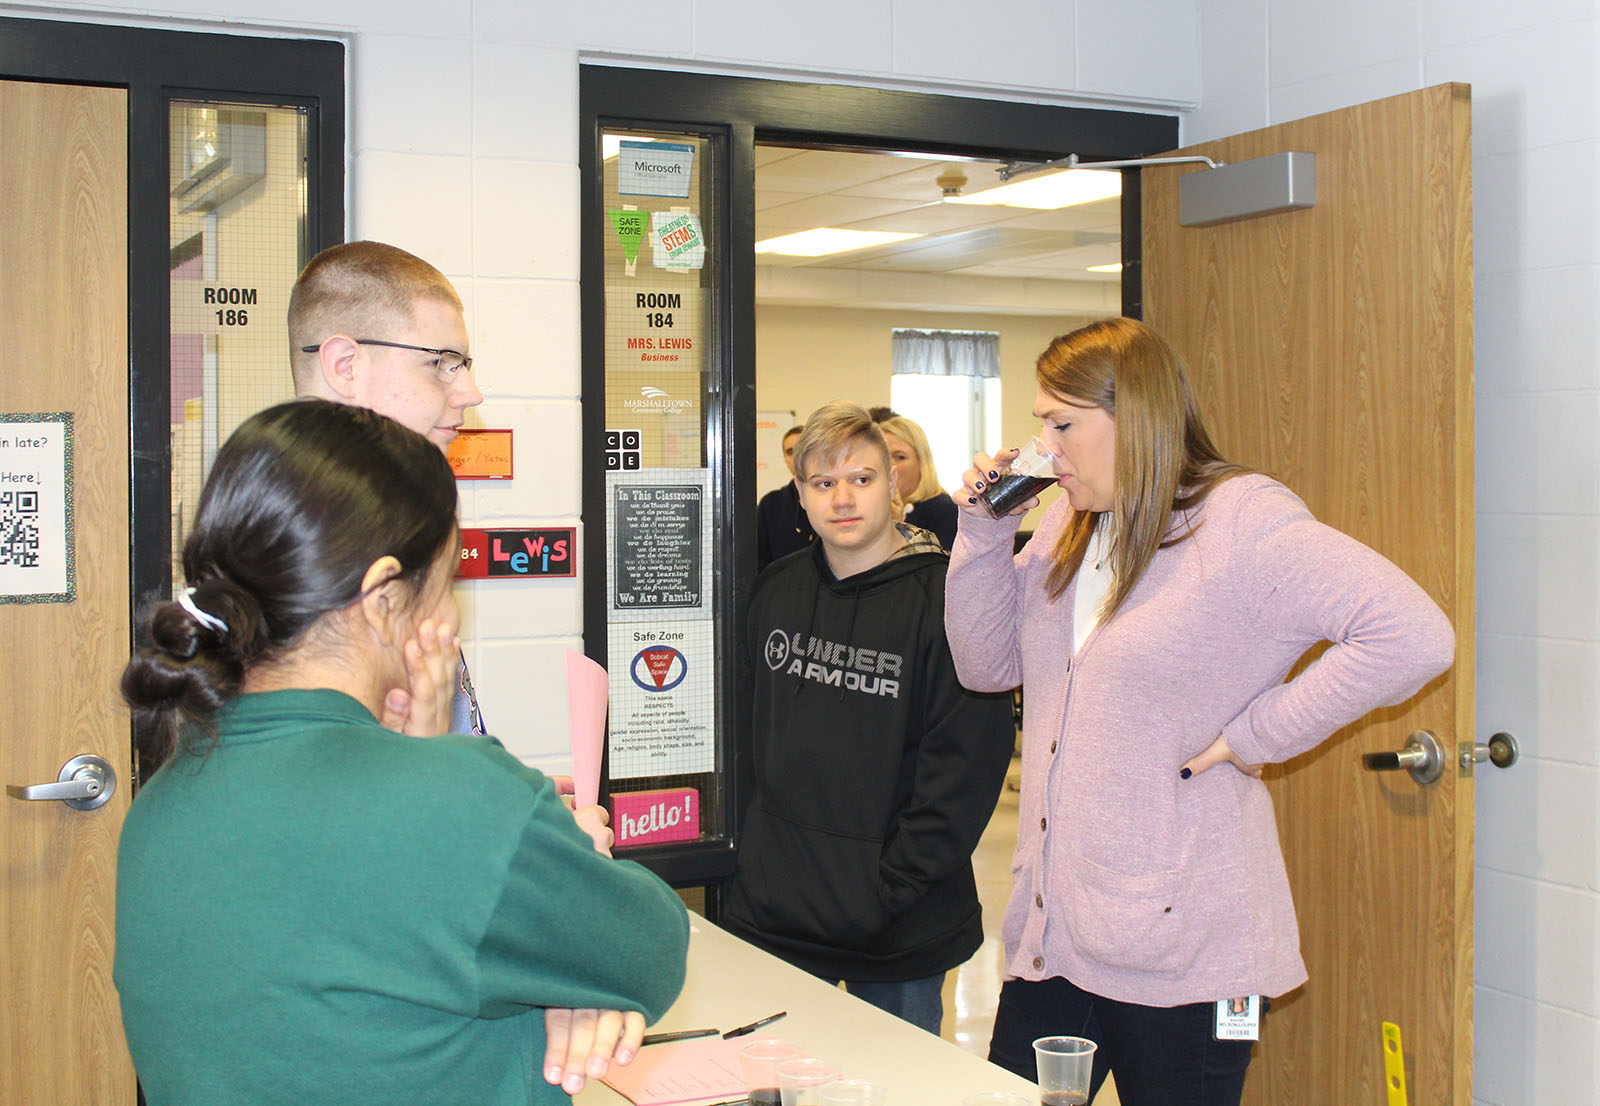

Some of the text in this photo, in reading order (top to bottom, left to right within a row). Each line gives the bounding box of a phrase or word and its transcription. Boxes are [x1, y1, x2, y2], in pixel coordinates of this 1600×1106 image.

[634, 162, 682, 176] Microsoft
[619, 217, 640, 227] SAFE
[658, 214, 689, 238] GREATNESS
[618, 226, 642, 236] ZONE
[662, 224, 697, 252] STEMS
[203, 287, 258, 305] ROOM
[637, 293, 681, 308] ROOM
[215, 309, 249, 327] 186
[646, 313, 674, 328] 184
[627, 337, 693, 350] MRS. LEWIS
[640, 352, 679, 362] Business
[623, 399, 693, 408] MARSHALLTOWN
[15, 436, 48, 448] late?
[1, 471, 34, 483] Here
[618, 490, 699, 500] In This Classroom
[460, 548, 479, 559] 84
[619, 592, 698, 604] We Are Family
[633, 631, 685, 641] Safe Zone
[791, 632, 903, 677] UNDER
[786, 658, 900, 698] ARMOUR
[621, 795, 690, 840] hello!
